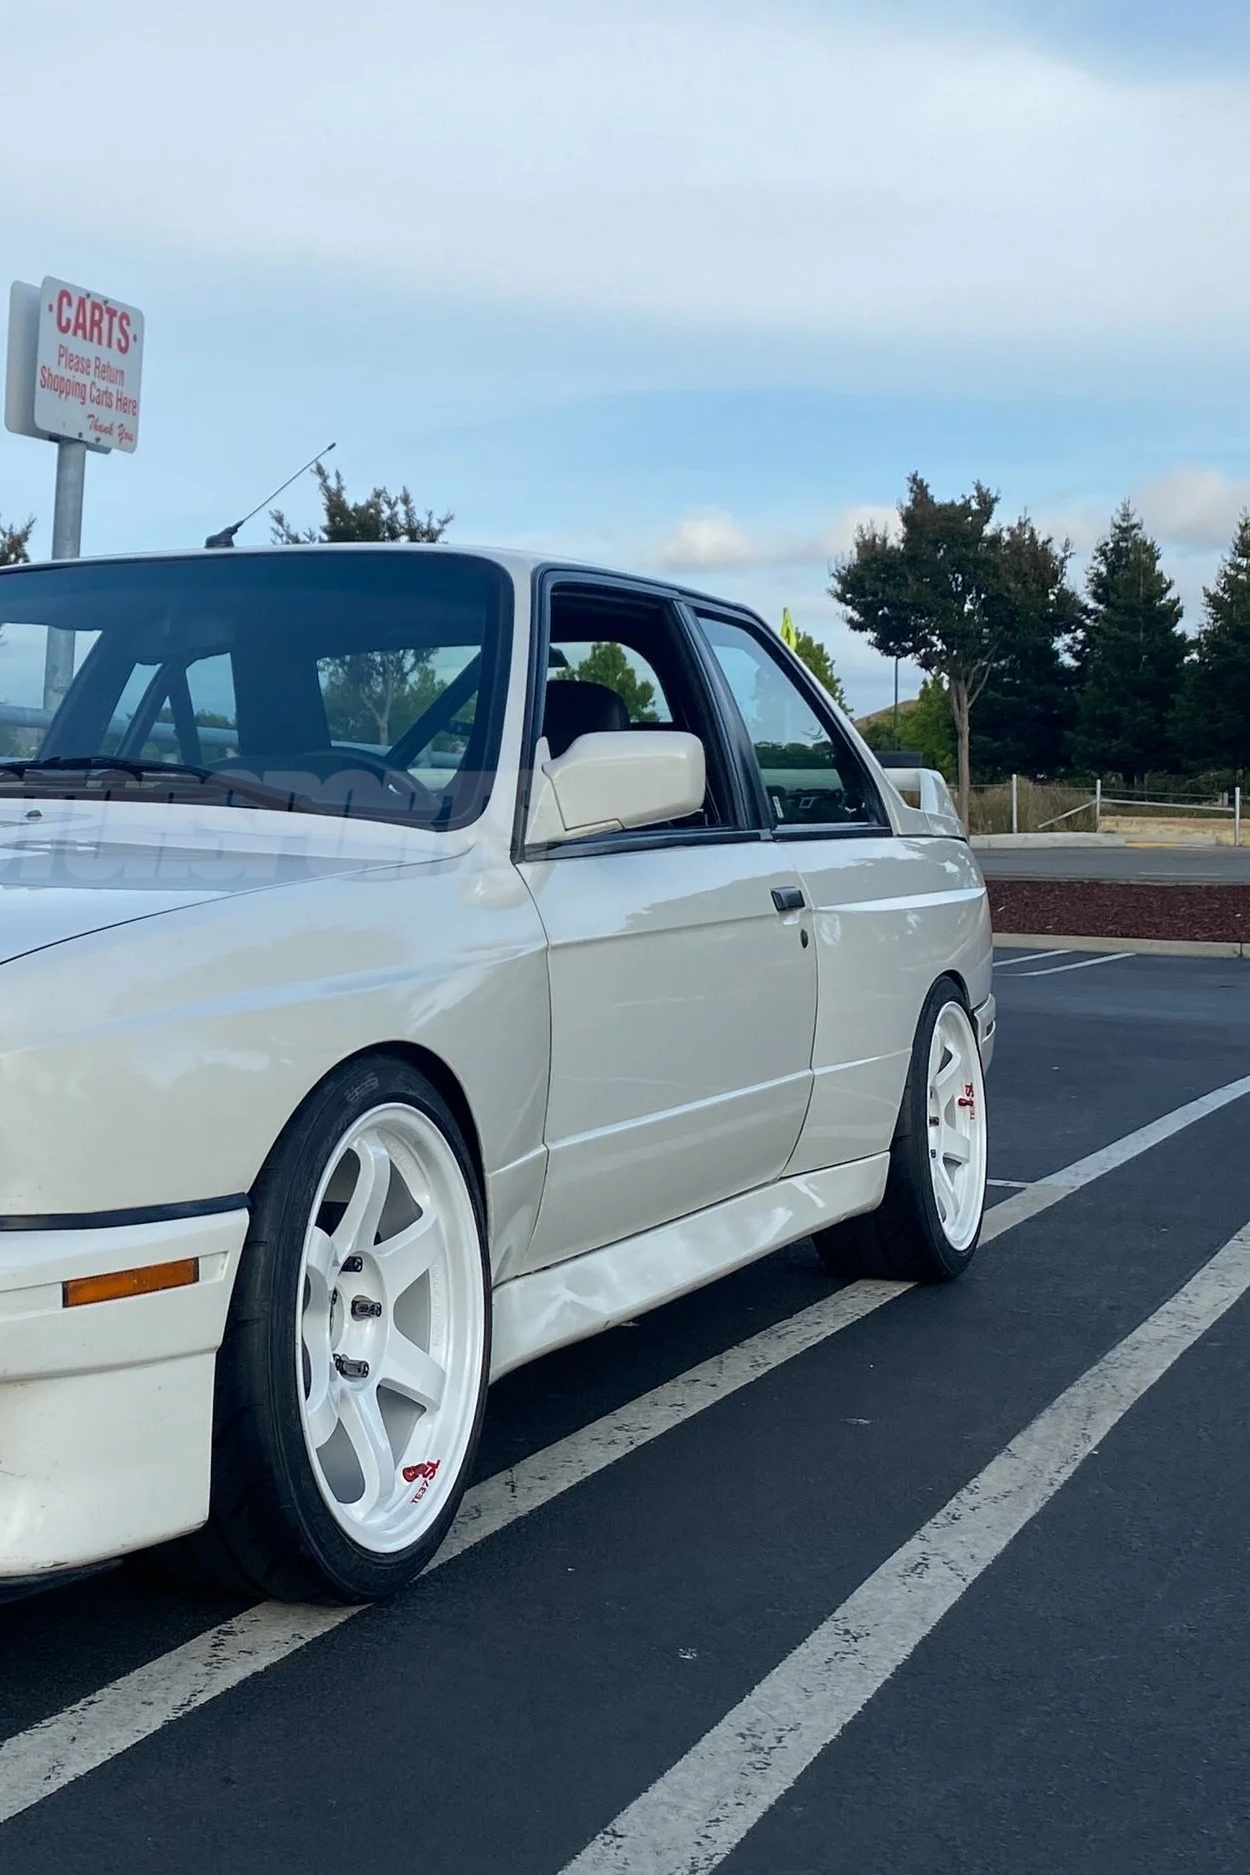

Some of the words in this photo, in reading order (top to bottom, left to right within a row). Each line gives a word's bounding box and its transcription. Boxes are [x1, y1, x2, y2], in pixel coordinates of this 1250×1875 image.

[56, 289, 131, 355] CARTS
[58, 344, 91, 376] Please
[94, 356, 125, 387] Return
[40, 365, 86, 406] Shopping
[89, 381, 113, 410] Carts
[116, 390, 138, 417] Here
[87, 414, 114, 436] Thank
[118, 424, 134, 443] You
[410, 1480, 429, 1504] TE37
